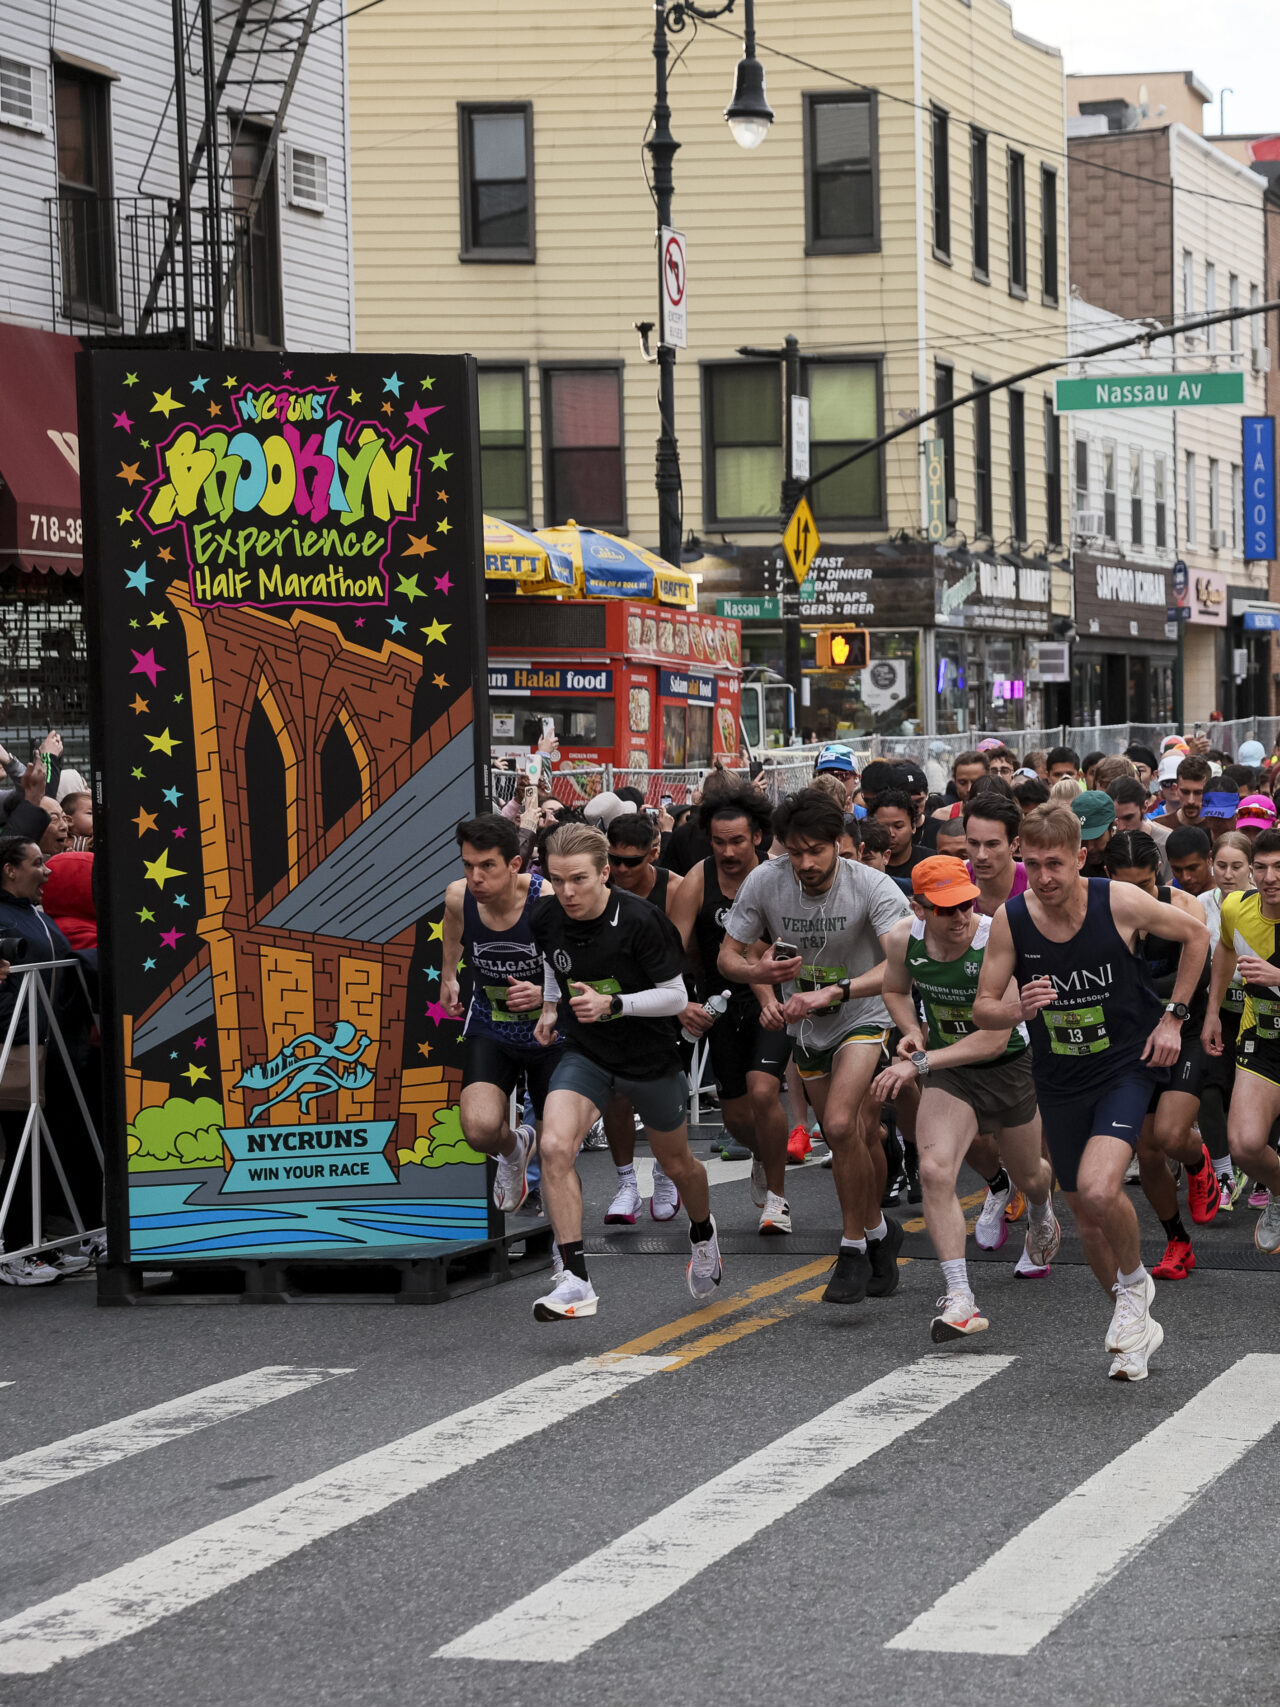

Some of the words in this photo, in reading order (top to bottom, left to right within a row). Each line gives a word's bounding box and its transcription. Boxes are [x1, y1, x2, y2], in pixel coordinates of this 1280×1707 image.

[1096, 384, 1168, 403] Nassau
[1178, 381, 1202, 400] Av
[239, 391, 326, 422] NYCRUNS
[928, 442, 943, 538] LOTTO
[1251, 423, 1267, 553] TACOS
[194, 521, 384, 567] Experience
[486, 555, 540, 573] RETT
[196, 567, 249, 600] Half
[260, 564, 383, 600] Marathon
[826, 569, 873, 580] DINNER
[660, 579, 690, 599] BRETT
[814, 581, 838, 591] BAR
[826, 592, 867, 603] WRAPS
[724, 602, 760, 616] Nassau
[799, 604, 833, 615] GERS
[843, 604, 874, 615] BEER
[514, 670, 561, 688] Halal
[566, 671, 607, 689] food
[699, 680, 712, 697] food
[782, 917, 847, 932] VERMONT
[472, 954, 546, 971] HELLGATE
[481, 968, 499, 979] ROAD
[501, 967, 543, 978] RUNNERS
[1077, 992, 1110, 1003] RESORTS
[954, 1022, 968, 1033] 11
[1274, 1017, 1280, 1028] 9
[1068, 1028, 1084, 1043] 13
[247, 1129, 368, 1153] NYCRUNS
[248, 1167, 281, 1182] WIN
[283, 1164, 325, 1180] YOUR
[329, 1162, 369, 1177] RACE
